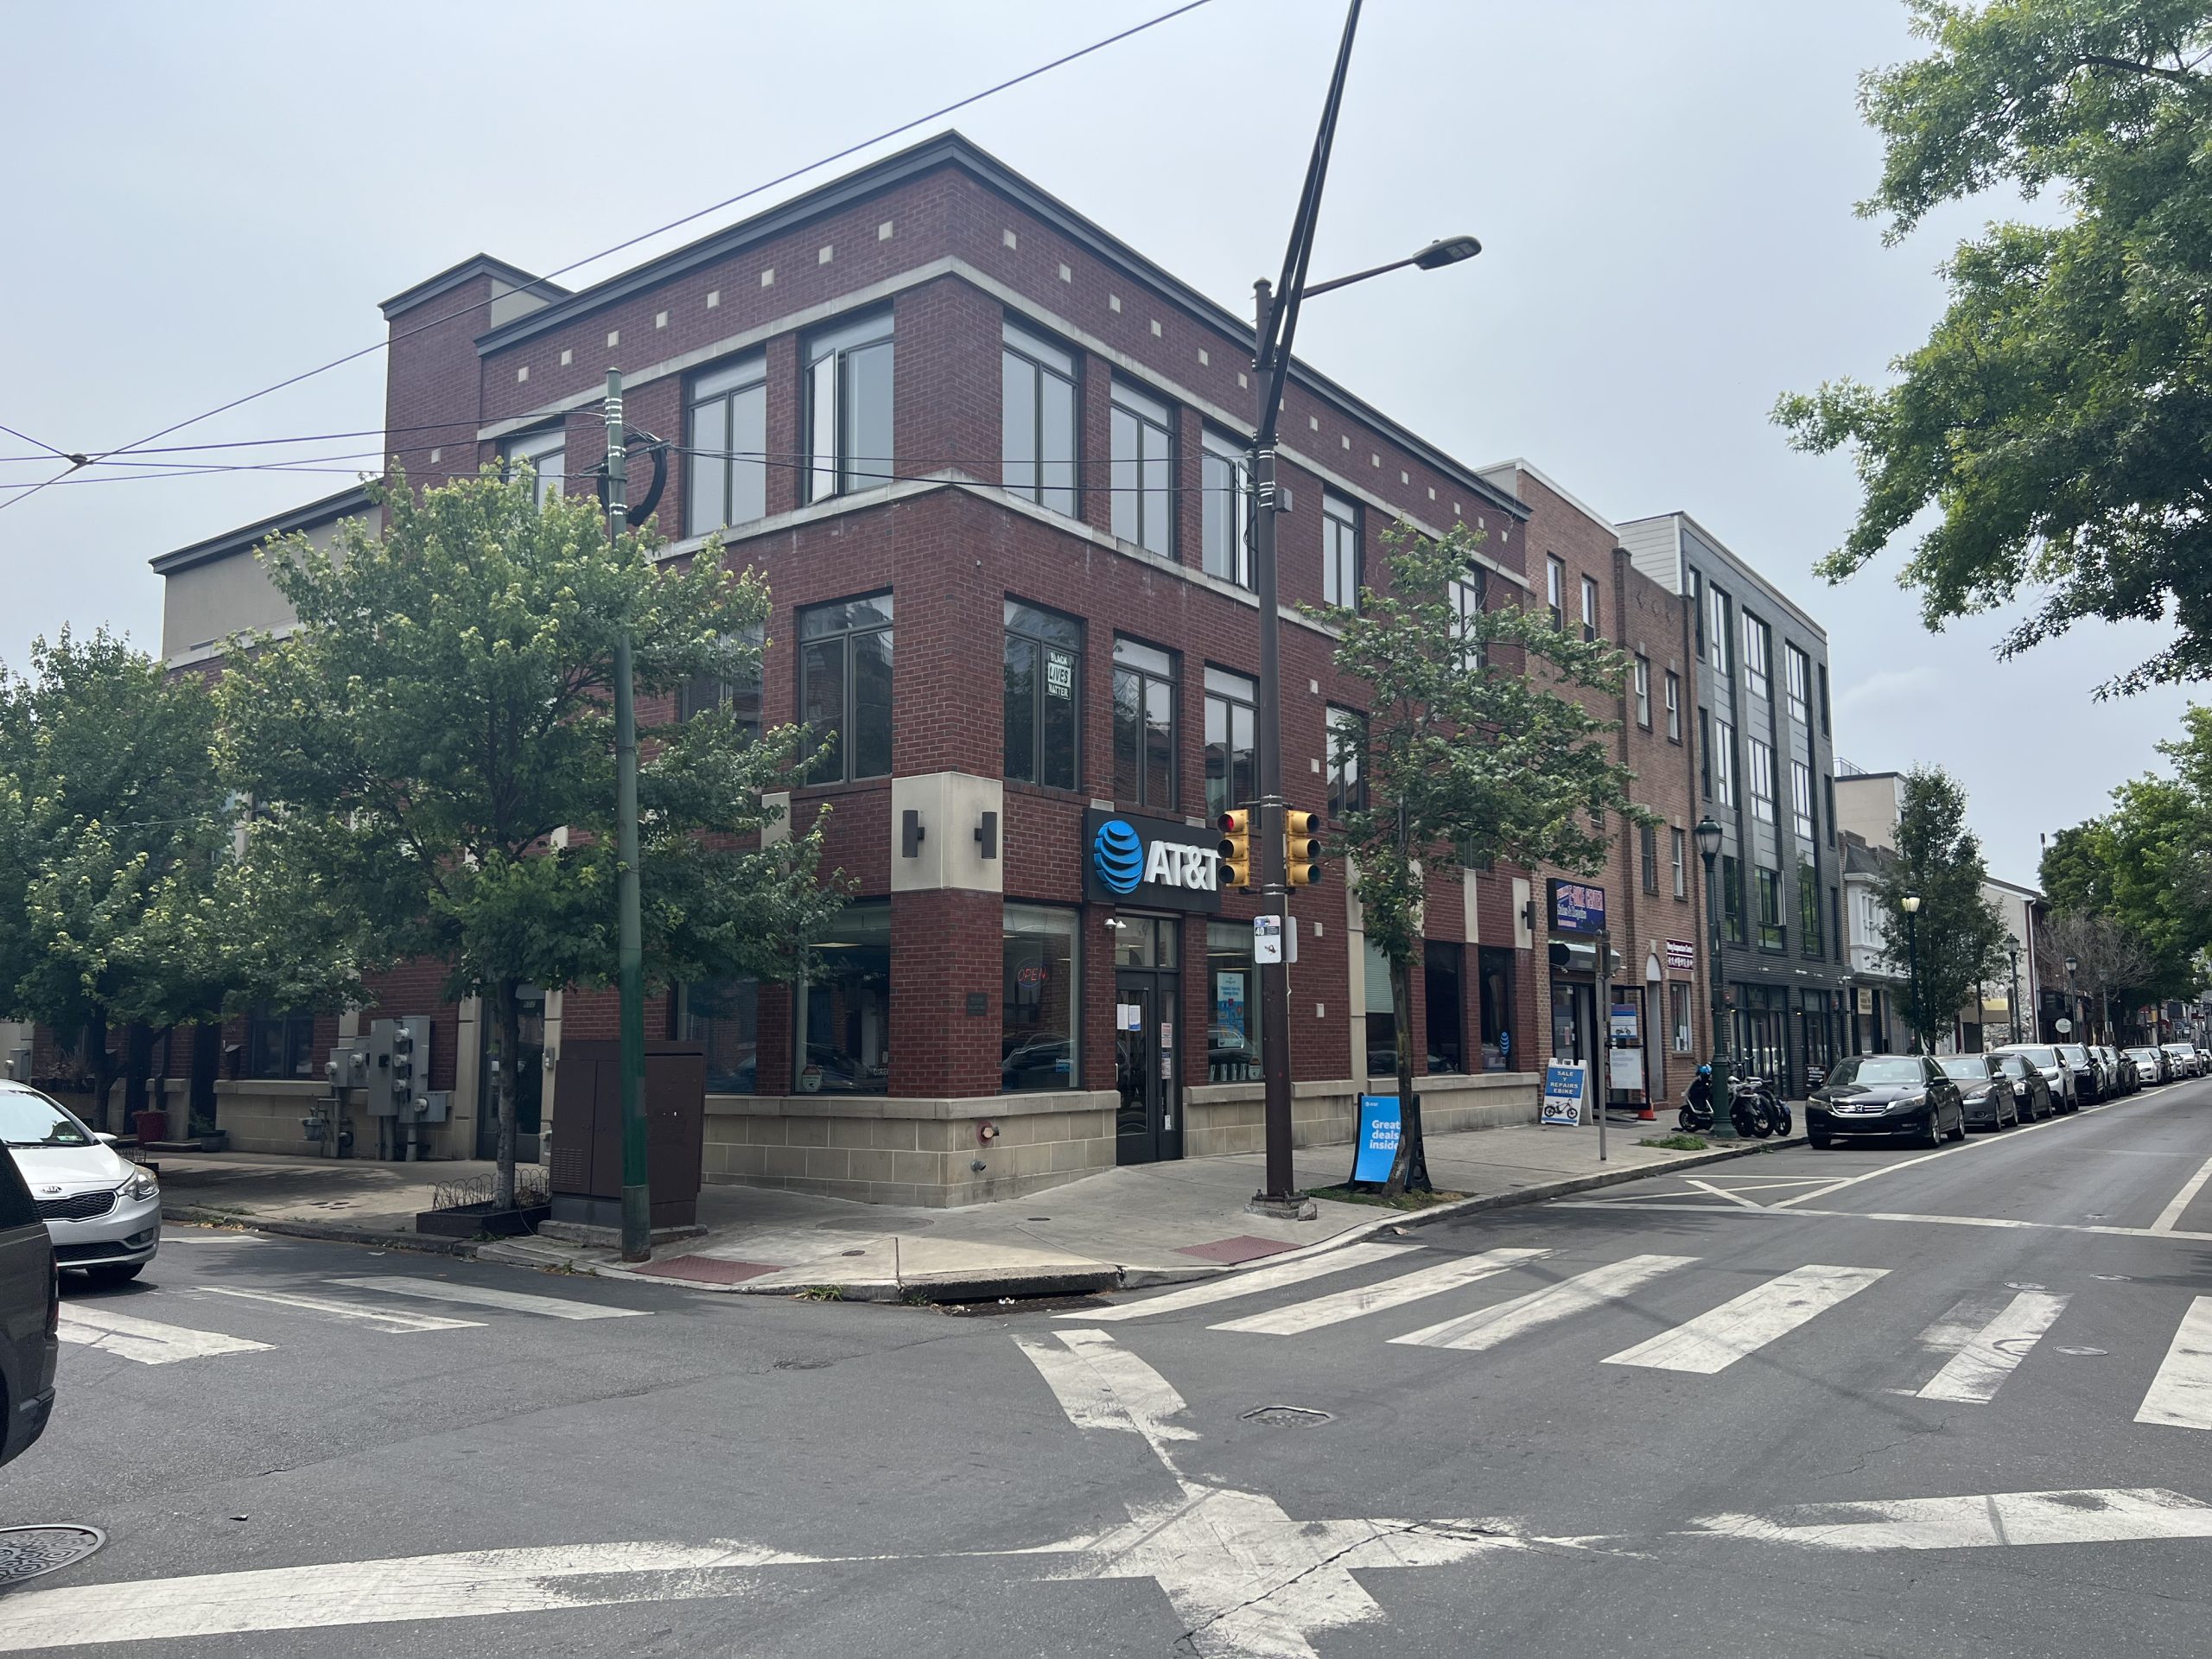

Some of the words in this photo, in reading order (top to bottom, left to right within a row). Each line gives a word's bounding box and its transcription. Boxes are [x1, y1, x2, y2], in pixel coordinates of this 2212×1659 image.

[1050, 652, 1068, 666] BLACK
[1049, 666, 1069, 683] LIVES
[1048, 683, 1069, 698] MATTER
[1143, 840, 1222, 891] AT&T
[1255, 927, 1265, 936] 40
[1017, 968, 1047, 982] OPEN
[1371, 1119, 1401, 1129] Great
[1371, 1130, 1400, 1140] deals
